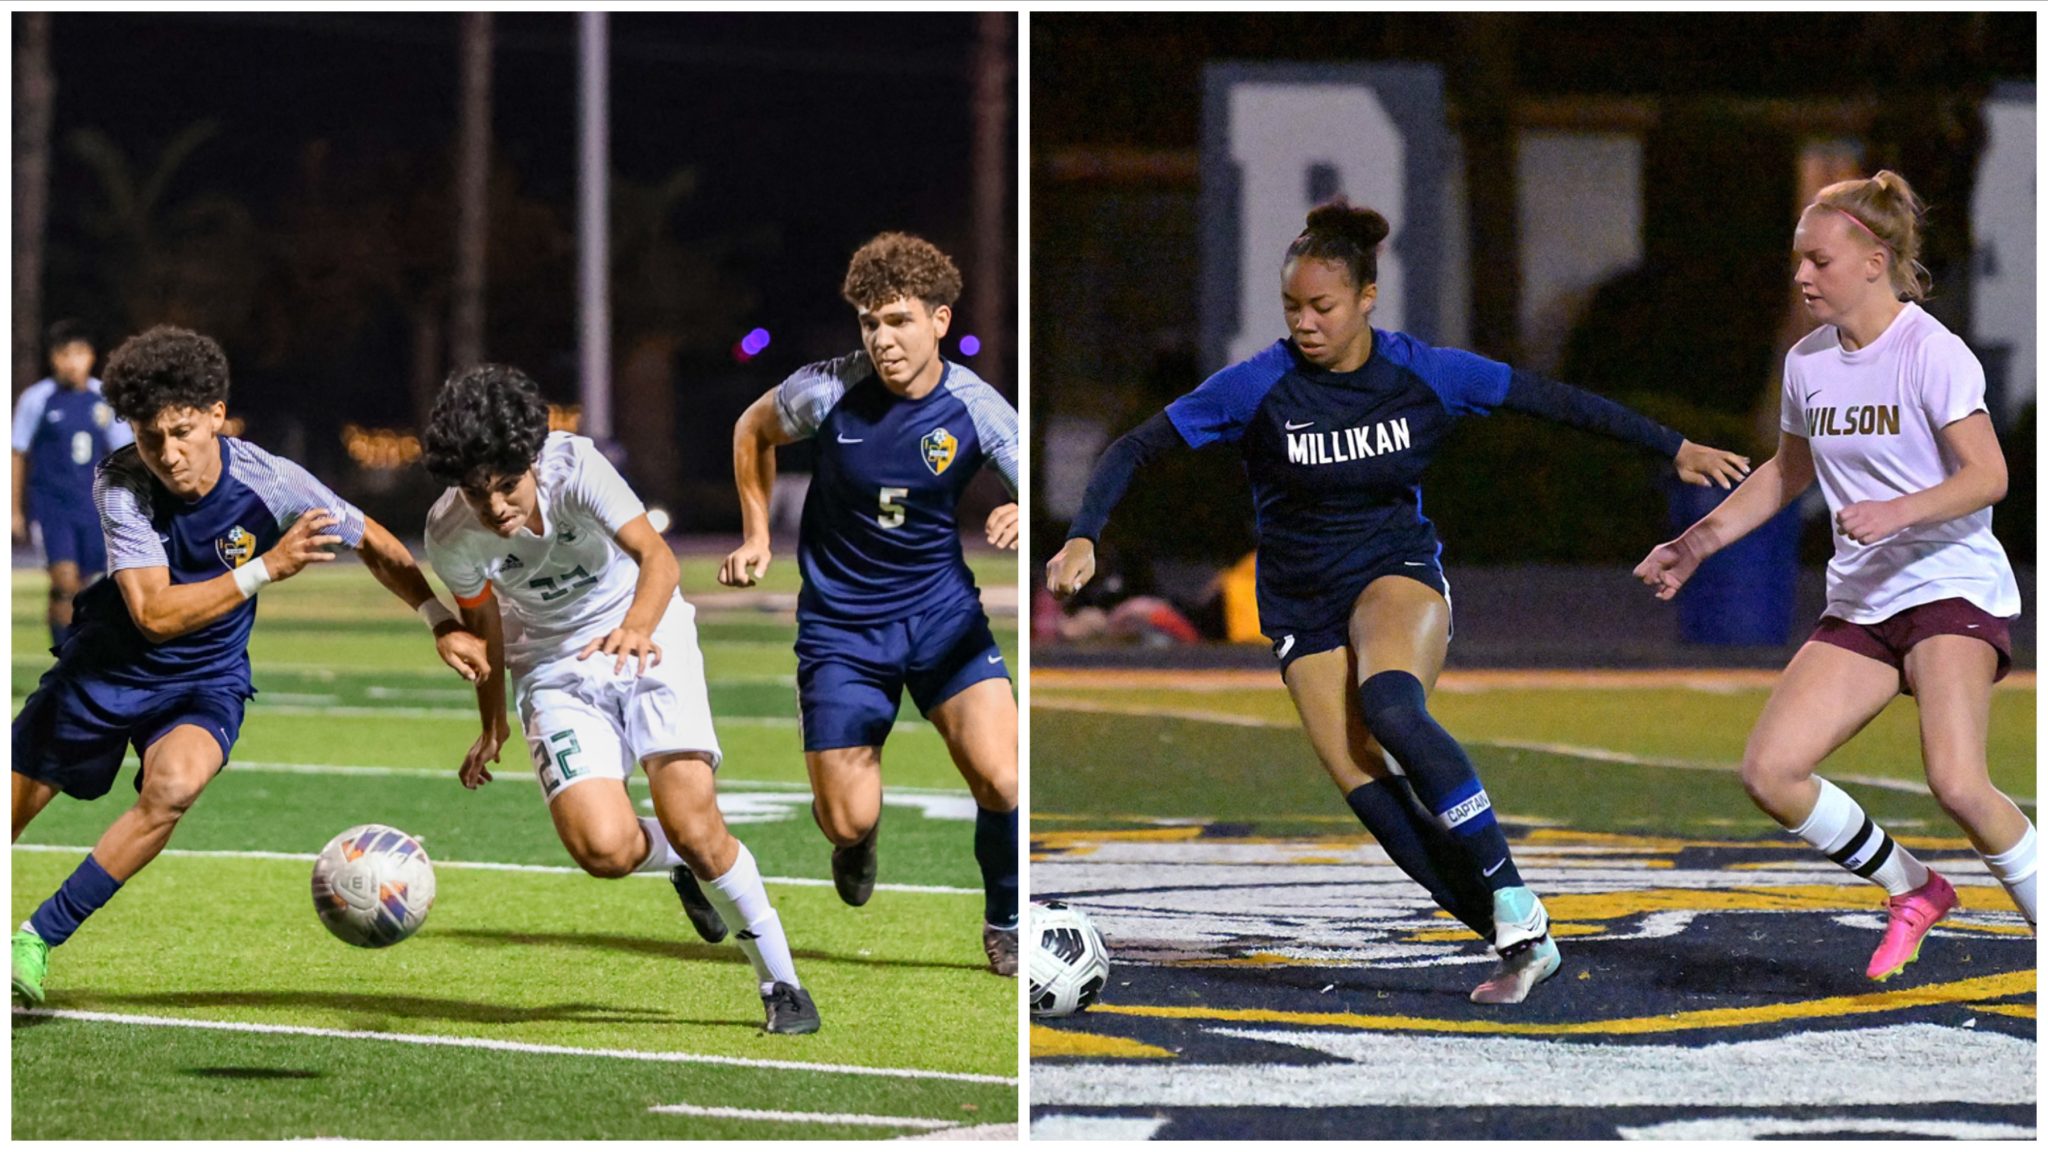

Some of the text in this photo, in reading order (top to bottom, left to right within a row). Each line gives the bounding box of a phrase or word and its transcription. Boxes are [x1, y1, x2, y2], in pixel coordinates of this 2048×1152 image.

[1286, 417, 1411, 465] MILLIKAN
[878, 486, 909, 529] 5
[534, 729, 591, 798] 22
